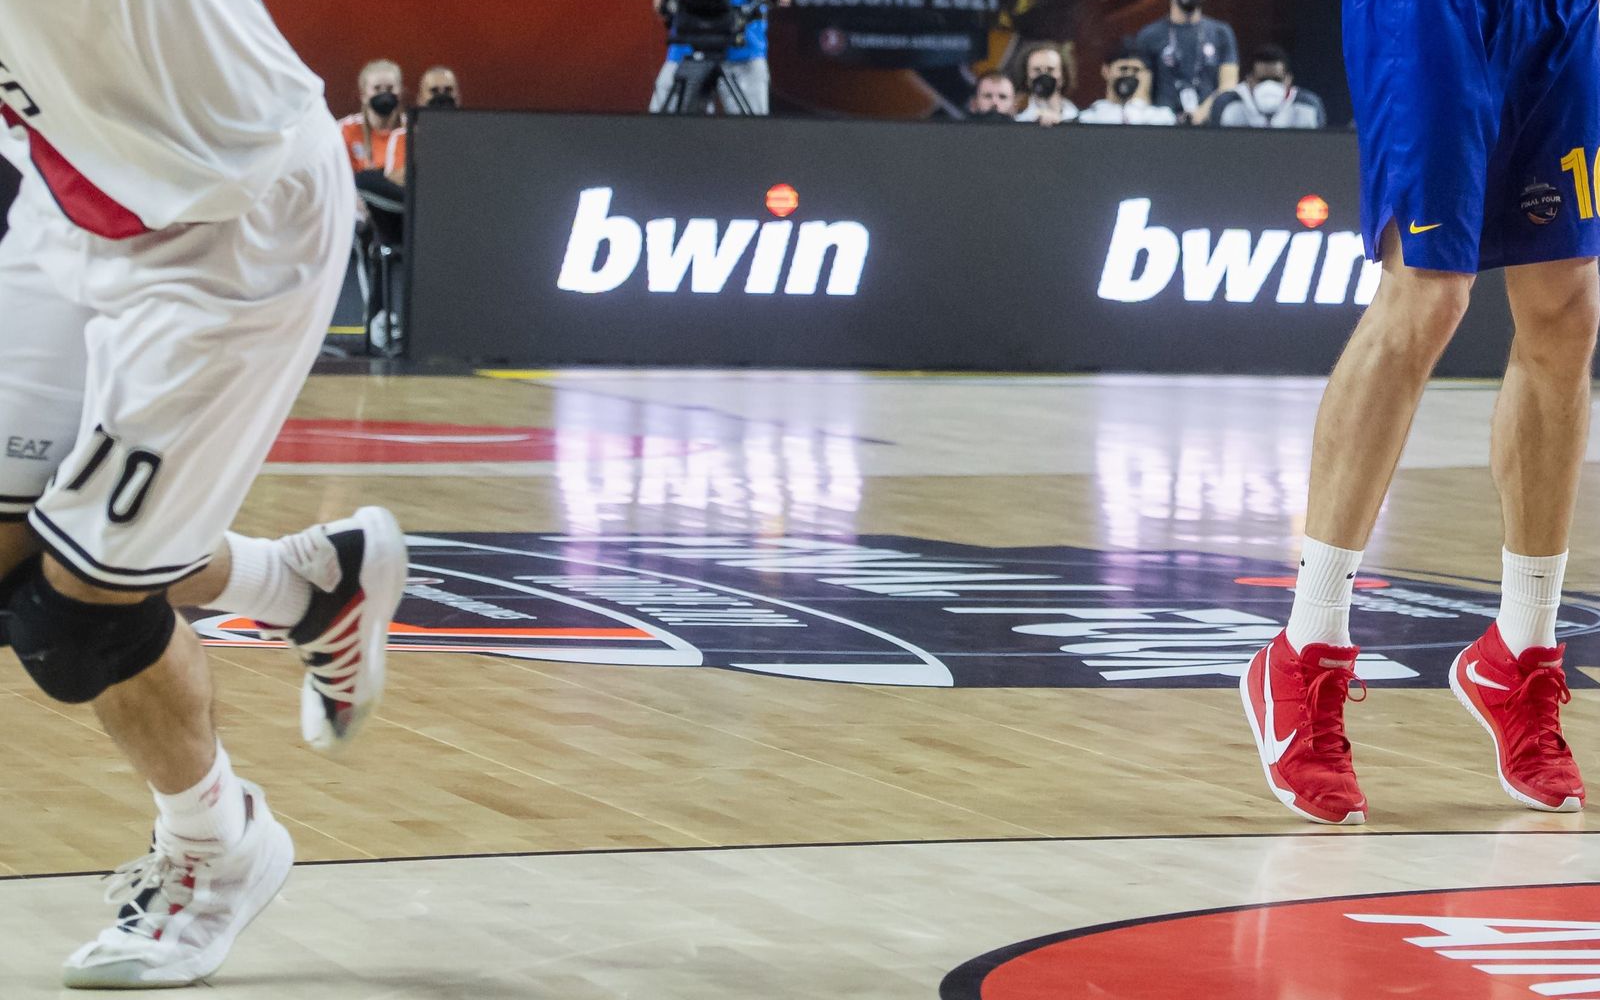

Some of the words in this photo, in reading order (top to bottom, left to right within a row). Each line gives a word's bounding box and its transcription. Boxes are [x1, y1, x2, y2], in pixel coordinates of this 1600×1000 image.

[557, 183, 869, 296] bwin
[1097, 194, 1382, 304] bwin
[6, 435, 53, 457] EA7
